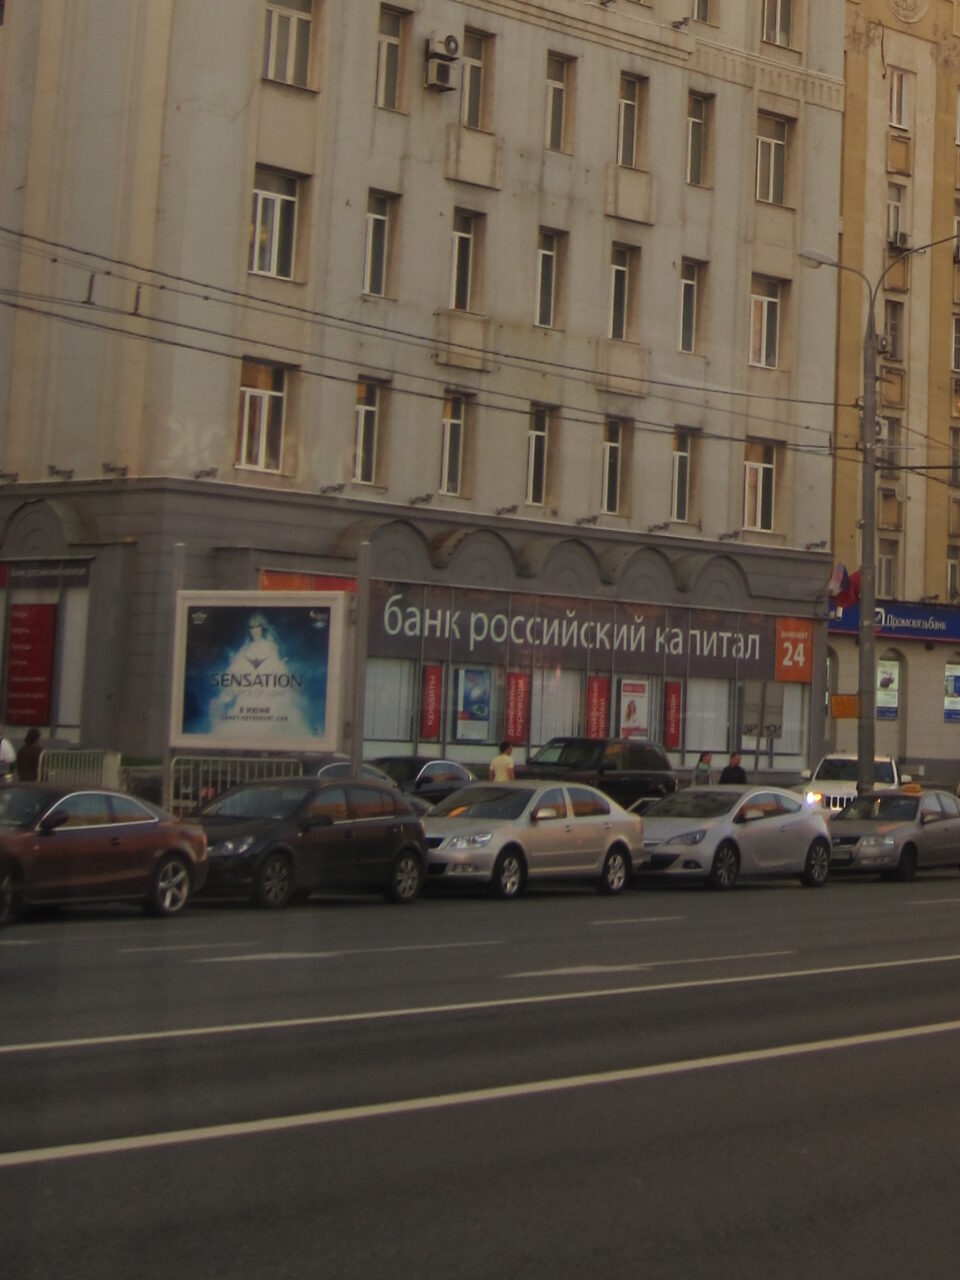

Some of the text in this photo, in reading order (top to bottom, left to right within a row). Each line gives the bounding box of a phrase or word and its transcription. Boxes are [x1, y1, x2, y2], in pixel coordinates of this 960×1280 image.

[383, 593, 761, 660] банк российский капитал
[886, 613, 947, 631] Промсвязьбанк
[782, 642, 805, 667] 24
[210, 673, 304, 688] SENSATION
[427, 674, 436, 726] кредиты
